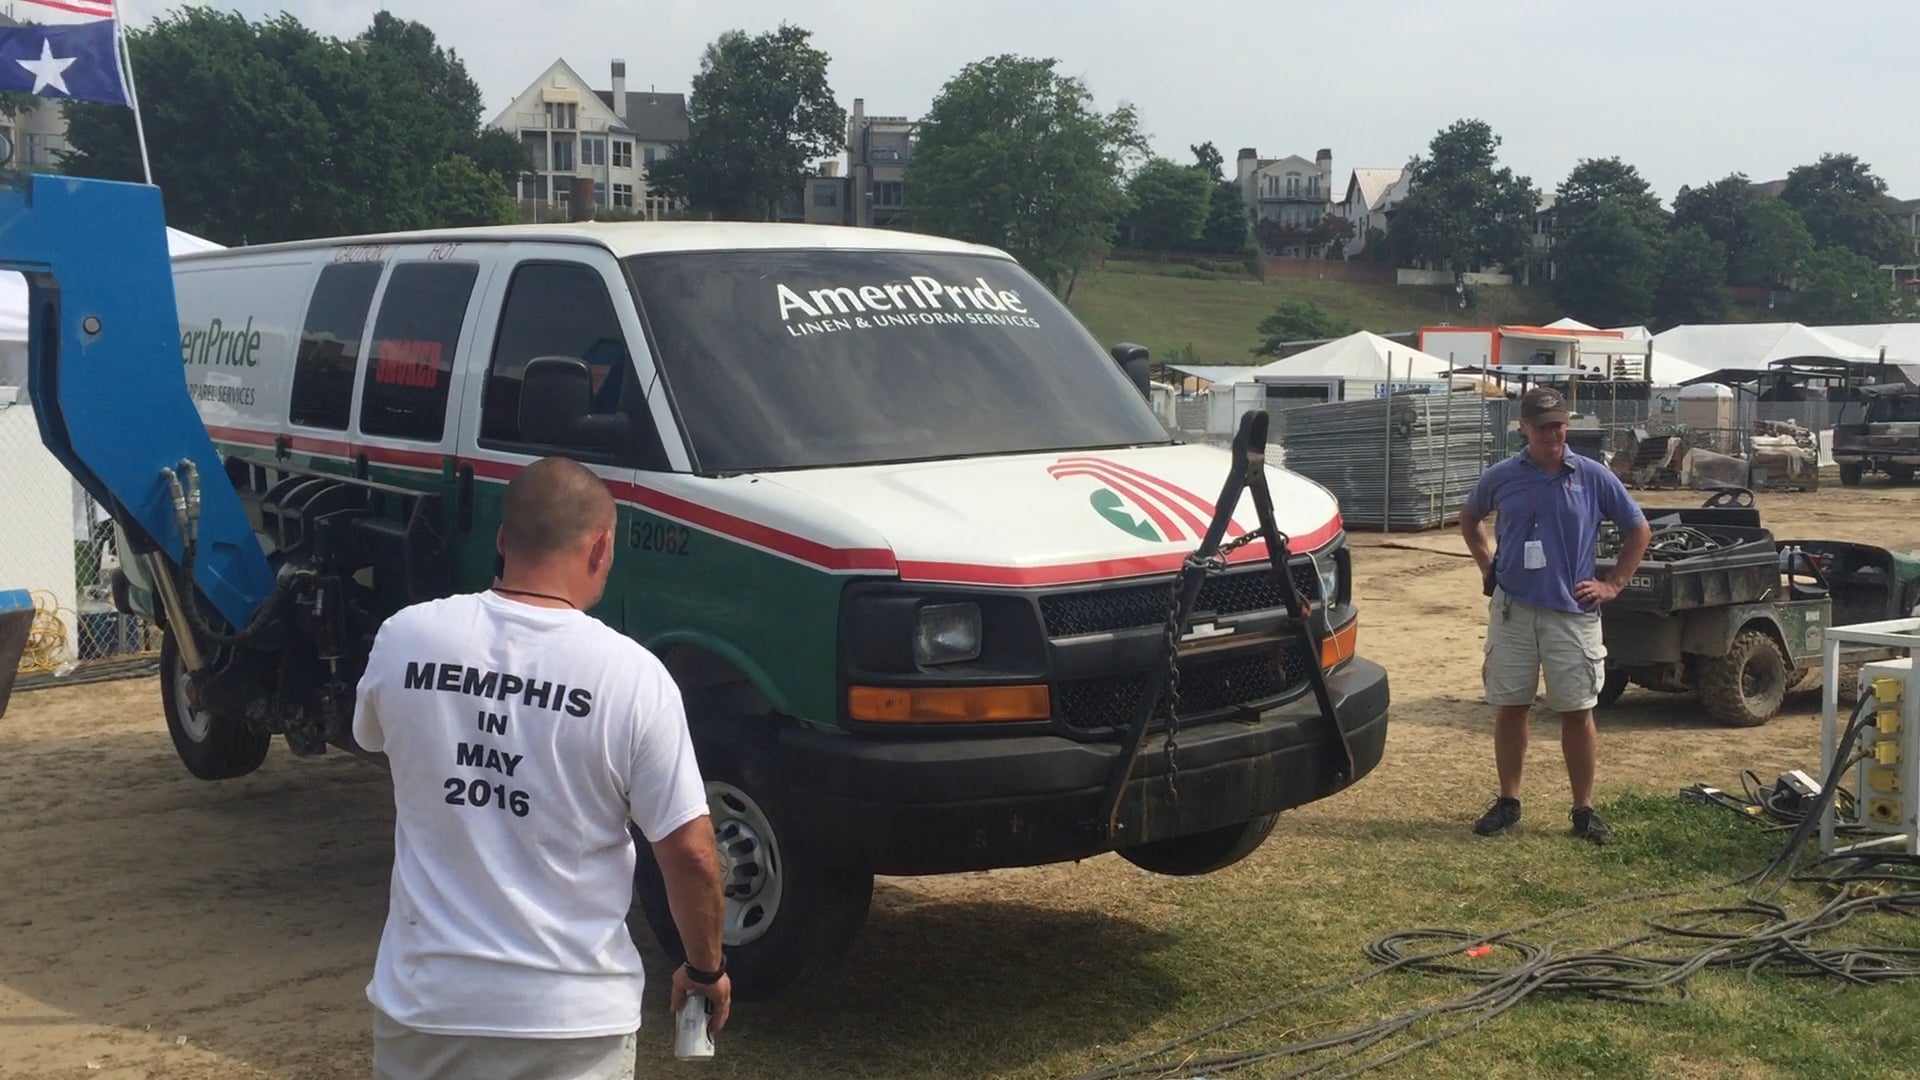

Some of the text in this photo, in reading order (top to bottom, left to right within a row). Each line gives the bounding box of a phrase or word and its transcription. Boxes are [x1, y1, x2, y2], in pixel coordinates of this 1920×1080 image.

[427, 242, 463, 260] HOT
[776, 275, 1028, 321] AmeriPride
[786, 311, 1041, 338] LINEN & UNIFORM SERVICES
[217, 385, 255, 406] SERVICES
[629, 520, 690, 557] 52082
[1625, 576, 1652, 588] GO
[404, 661, 592, 718] MEMPHIS
[477, 710, 508, 736] IN
[456, 742, 523, 777] MAY
[443, 777, 530, 818] 2016
